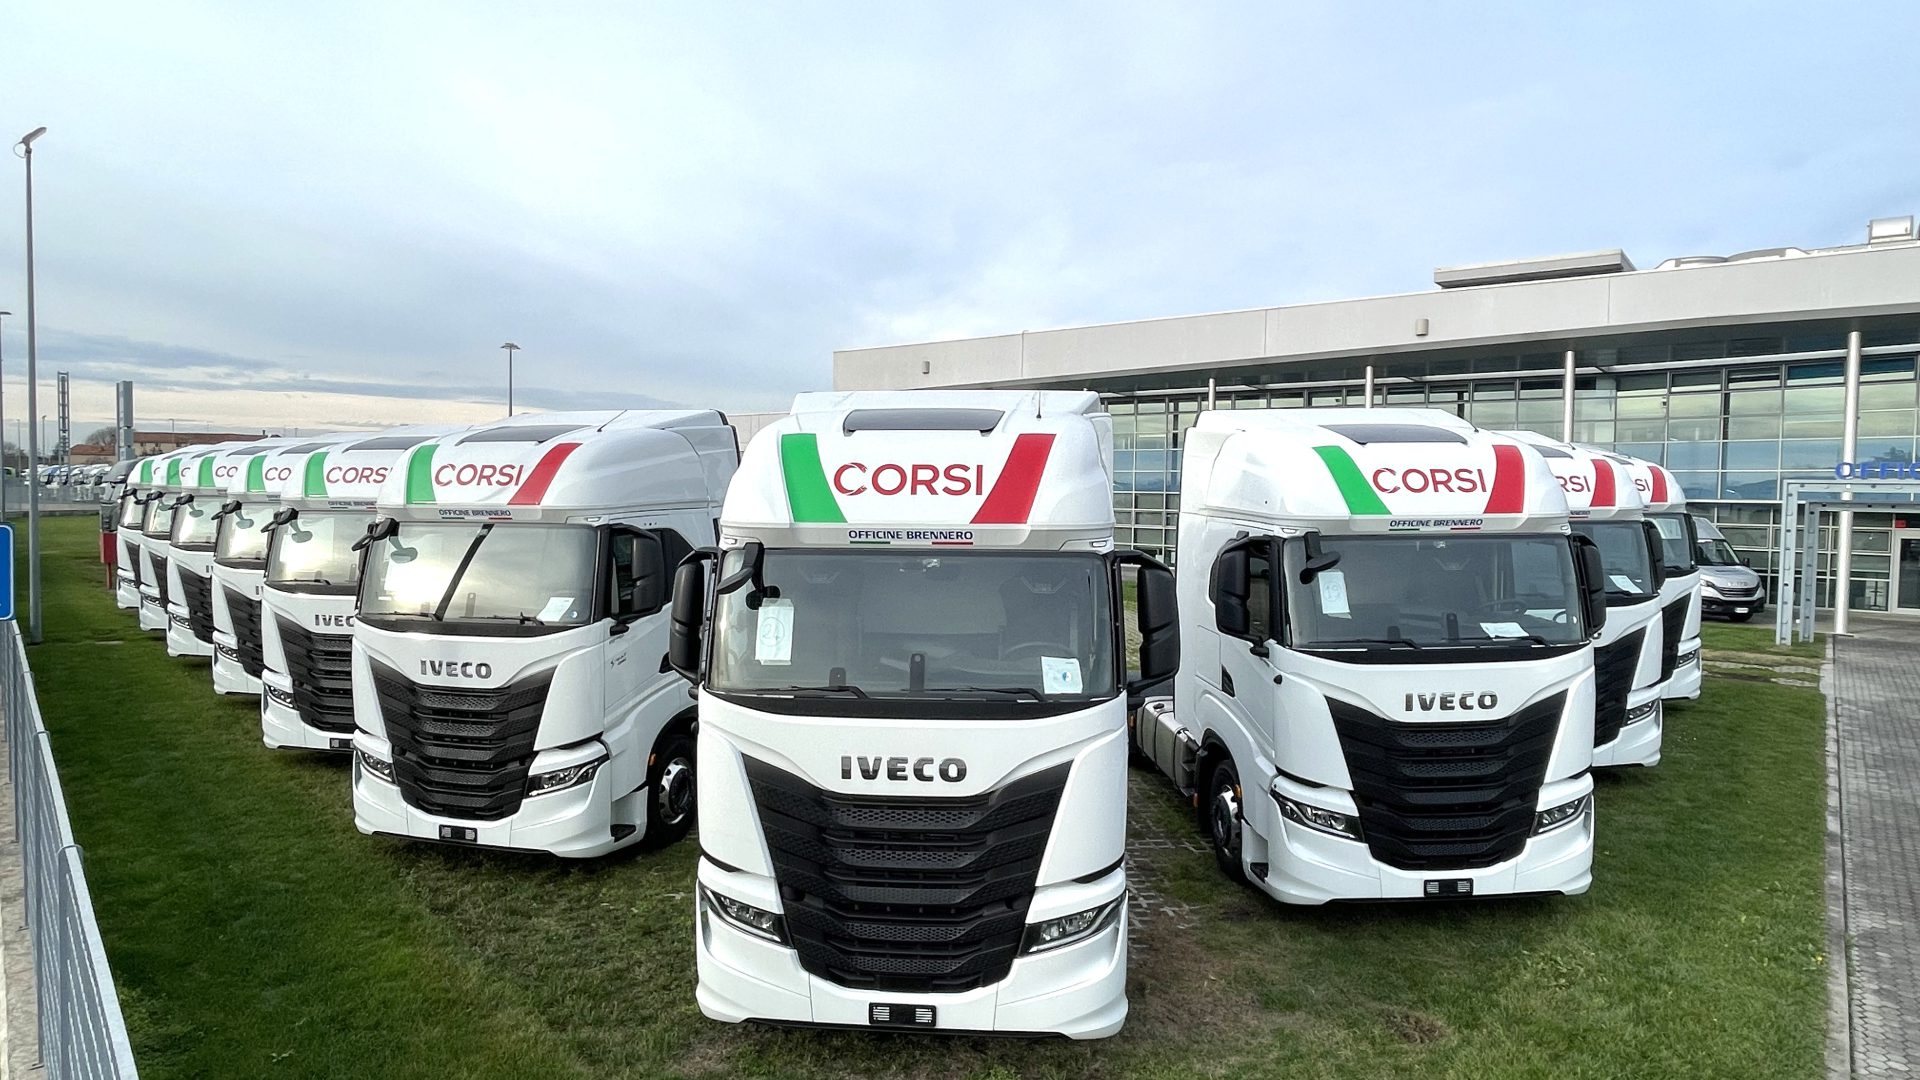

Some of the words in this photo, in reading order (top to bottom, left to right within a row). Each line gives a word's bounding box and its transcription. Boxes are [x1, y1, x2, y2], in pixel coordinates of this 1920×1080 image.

[434, 464, 524, 487] CORSI
[834, 462, 983, 496] CORSI
[1372, 468, 1487, 493] CORSI
[1835, 462, 1920, 480] OFFIC
[1556, 475, 1591, 493] RSI
[1389, 519, 1431, 528] OFFICINE
[1433, 518, 1484, 527] BRENNERO
[848, 530, 903, 540] OFFICINE
[906, 530, 974, 541] BRENNERO
[315, 614, 355, 628] IVEC
[420, 660, 492, 680] IVECO
[1405, 690, 1498, 712] IVECO
[840, 755, 967, 783] IVECO
